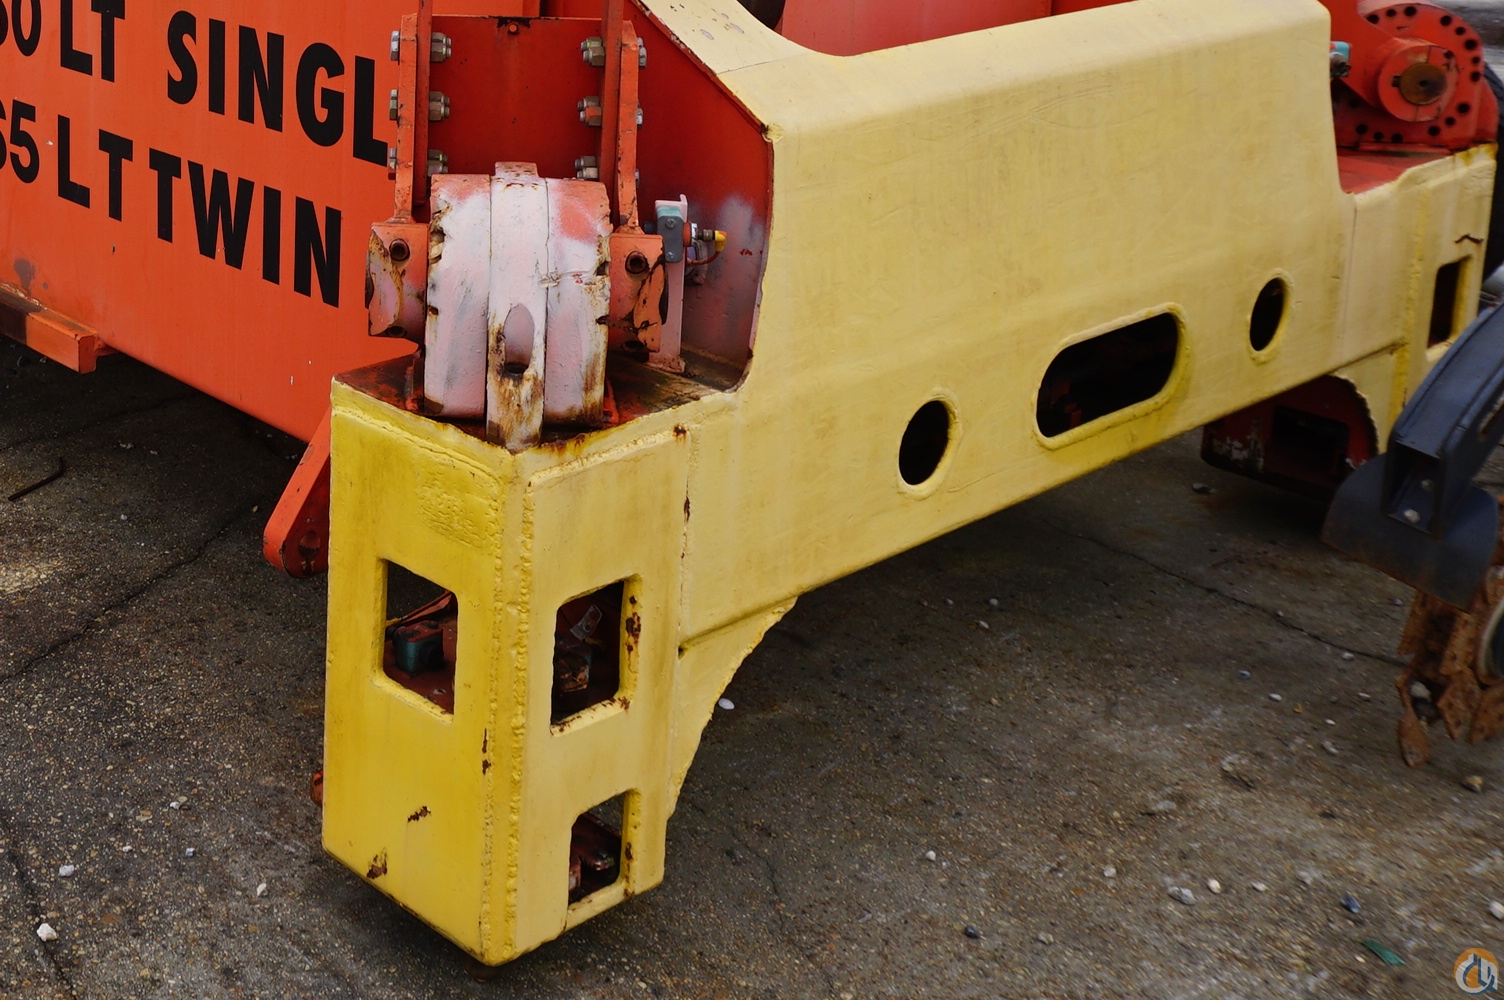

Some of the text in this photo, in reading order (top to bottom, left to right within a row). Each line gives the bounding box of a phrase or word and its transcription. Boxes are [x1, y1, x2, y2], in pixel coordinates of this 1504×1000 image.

[167, 10, 389, 167] SINGL
[57, 115, 133, 222] LT
[149, 148, 342, 308] TWIN
